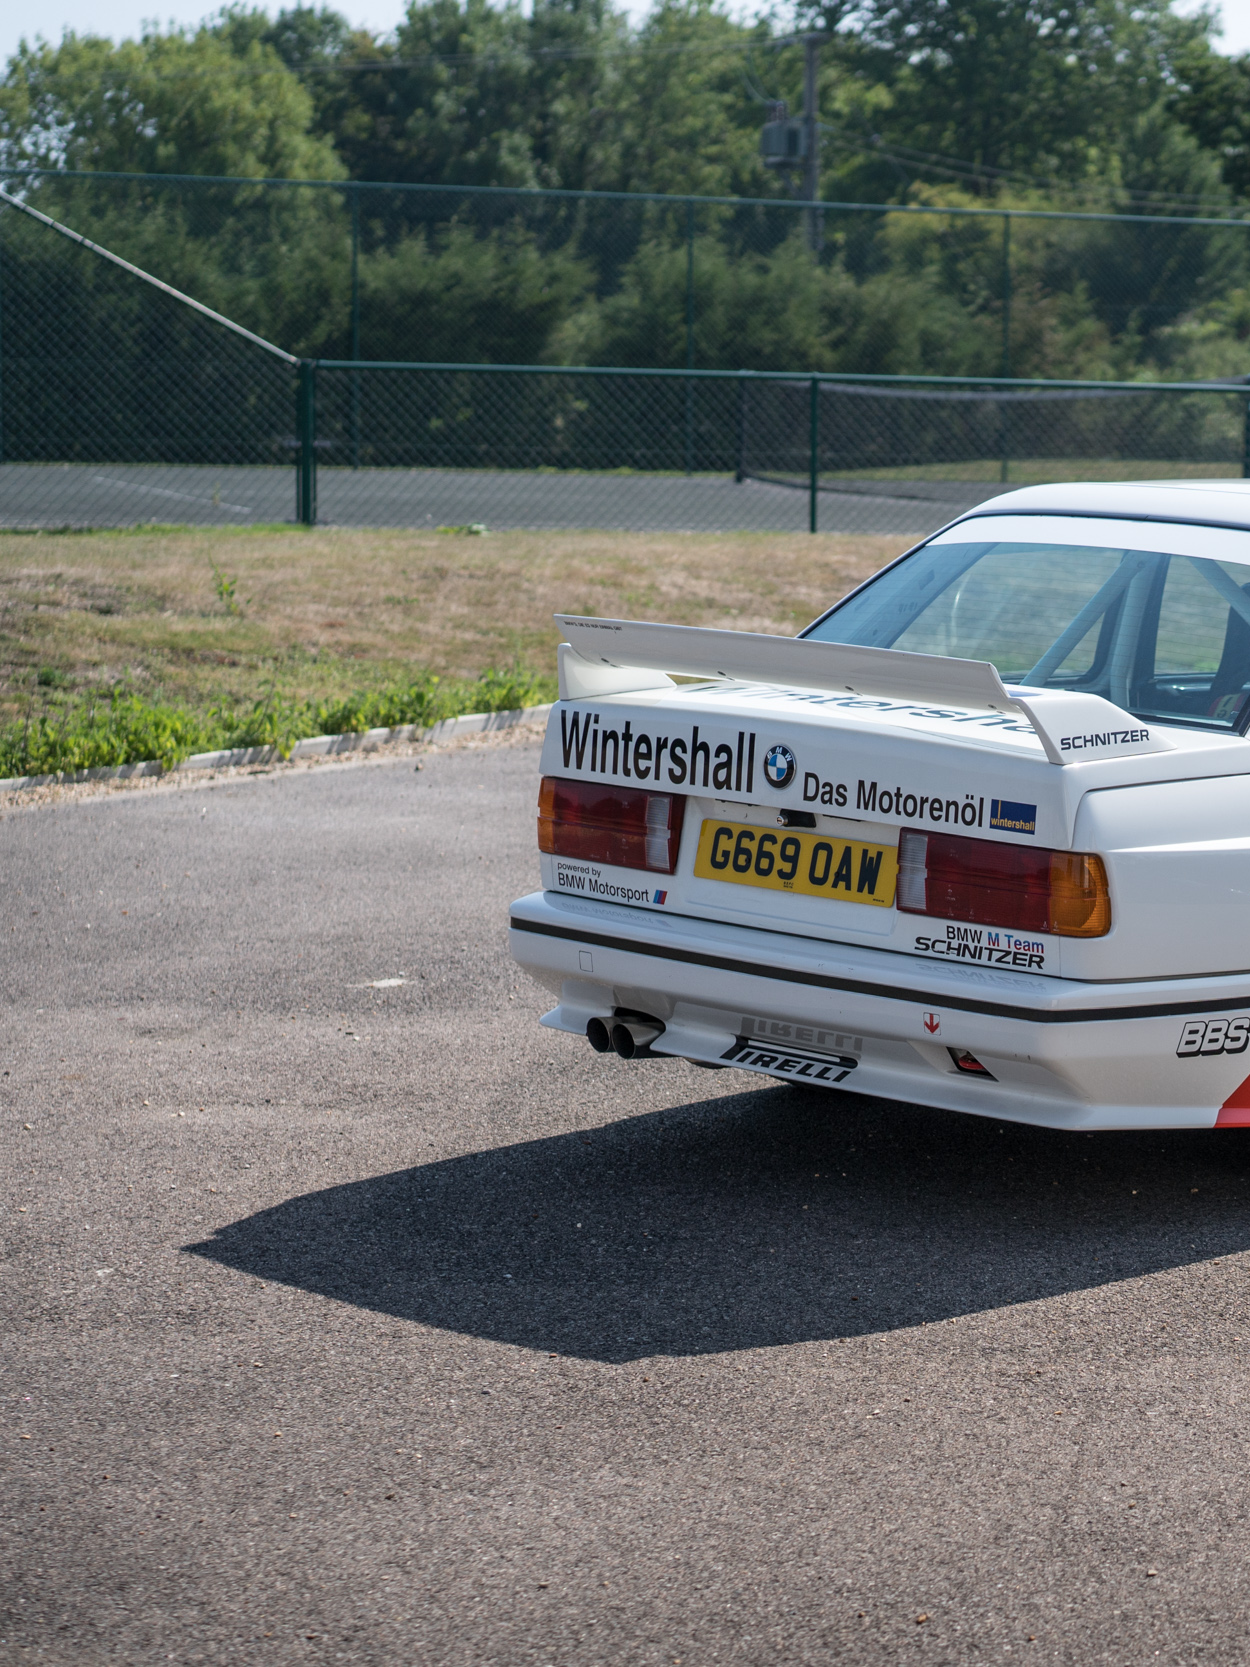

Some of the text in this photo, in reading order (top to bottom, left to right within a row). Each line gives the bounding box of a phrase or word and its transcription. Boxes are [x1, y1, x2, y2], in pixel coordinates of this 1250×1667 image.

[560, 709, 756, 793] Wintershall
[767, 746, 793, 762] BMW
[1060, 729, 1150, 751] SCHNITZER
[802, 772, 985, 828] Das Motorenöl
[990, 817, 1036, 831] wintershall
[557, 862, 602, 878] powered by
[709, 826, 884, 896] G669 OAW
[558, 872, 650, 902] BMW Motorsport
[914, 936, 1046, 970] SCHNITZER
[946, 925, 1045, 954] BMW M Team
[719, 1032, 859, 1083] PIRELLI
